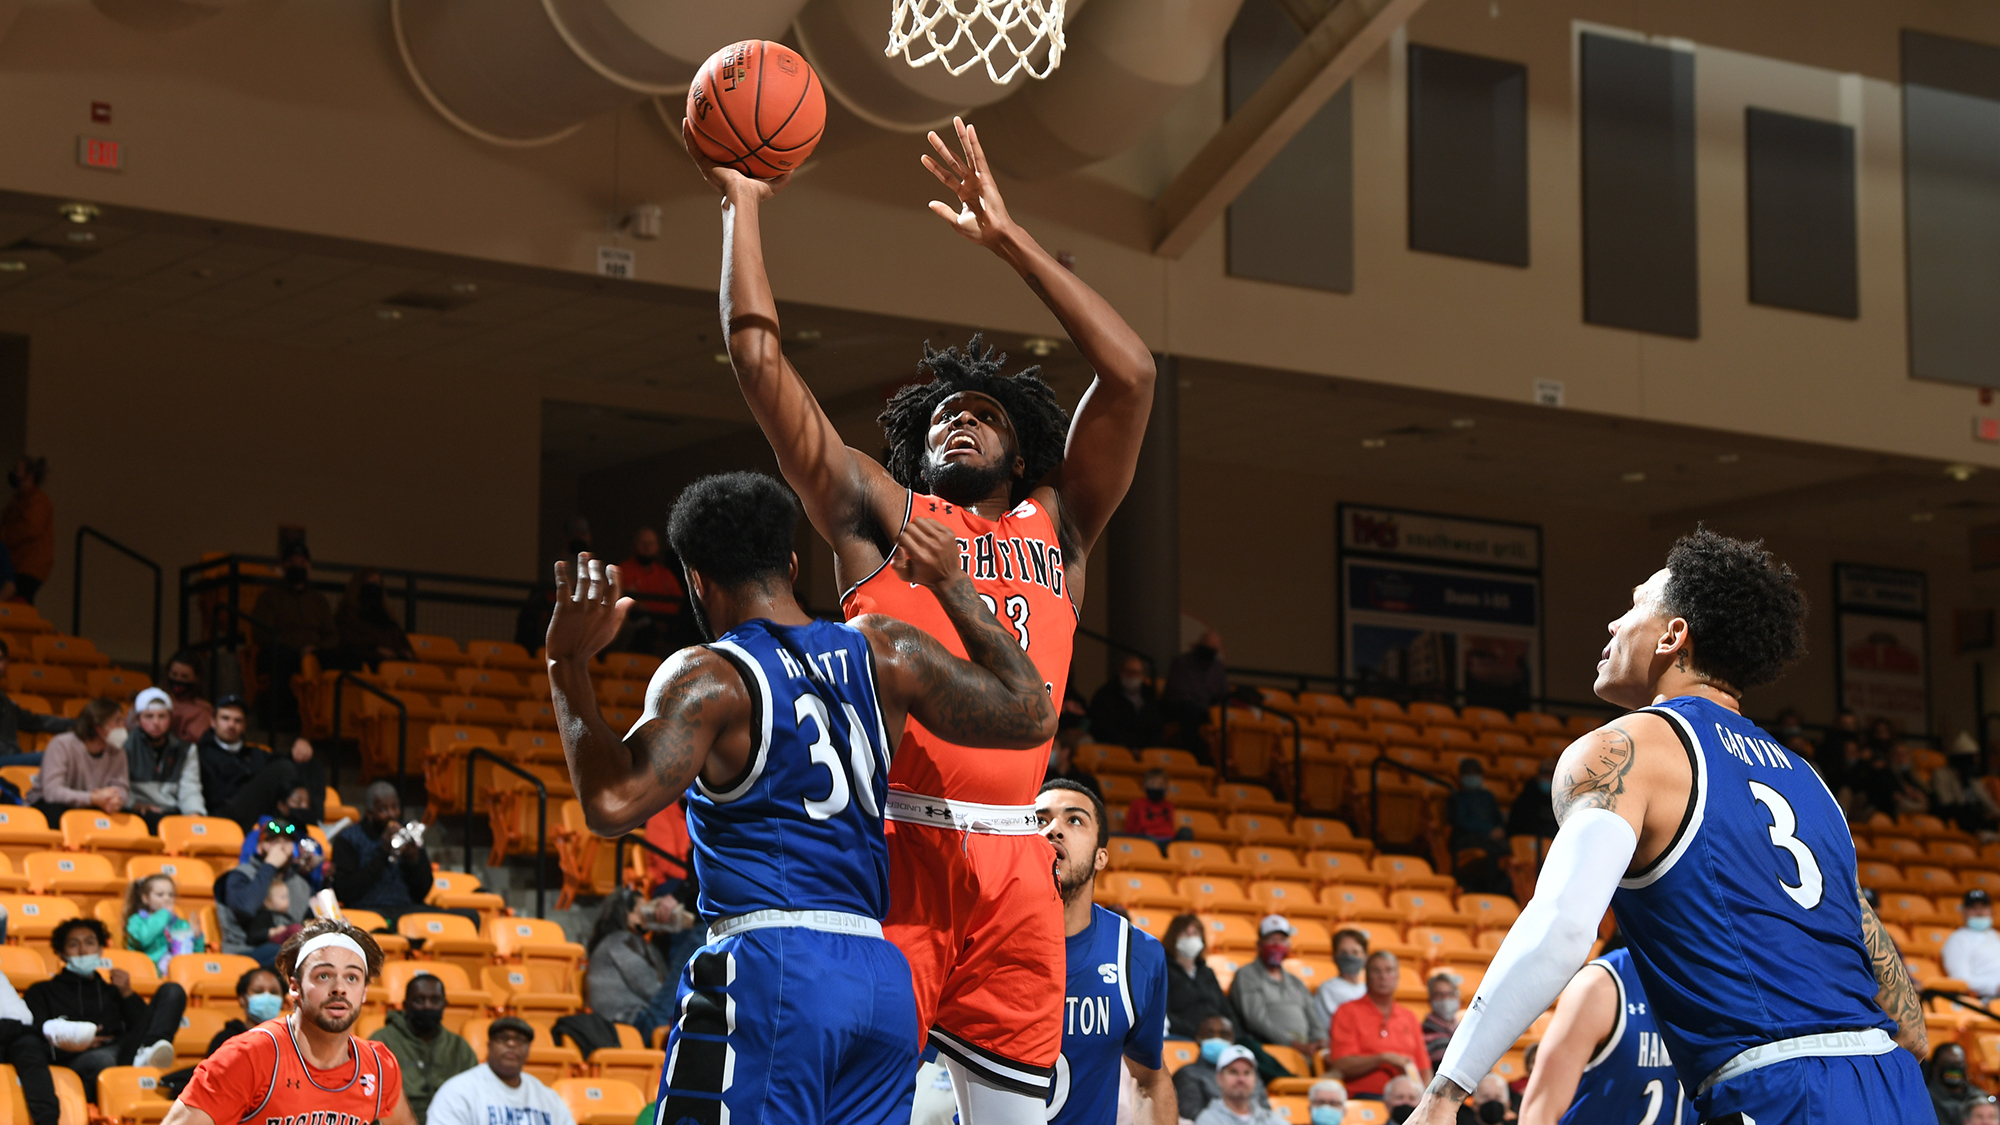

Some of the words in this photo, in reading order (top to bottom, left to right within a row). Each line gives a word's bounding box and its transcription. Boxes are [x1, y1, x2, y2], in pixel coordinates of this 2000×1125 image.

[88, 139, 118, 168] EXIT
[956, 532, 1064, 599] GHTING
[1714, 722, 1795, 771] GARVIN
[1748, 778, 1826, 912] 3
